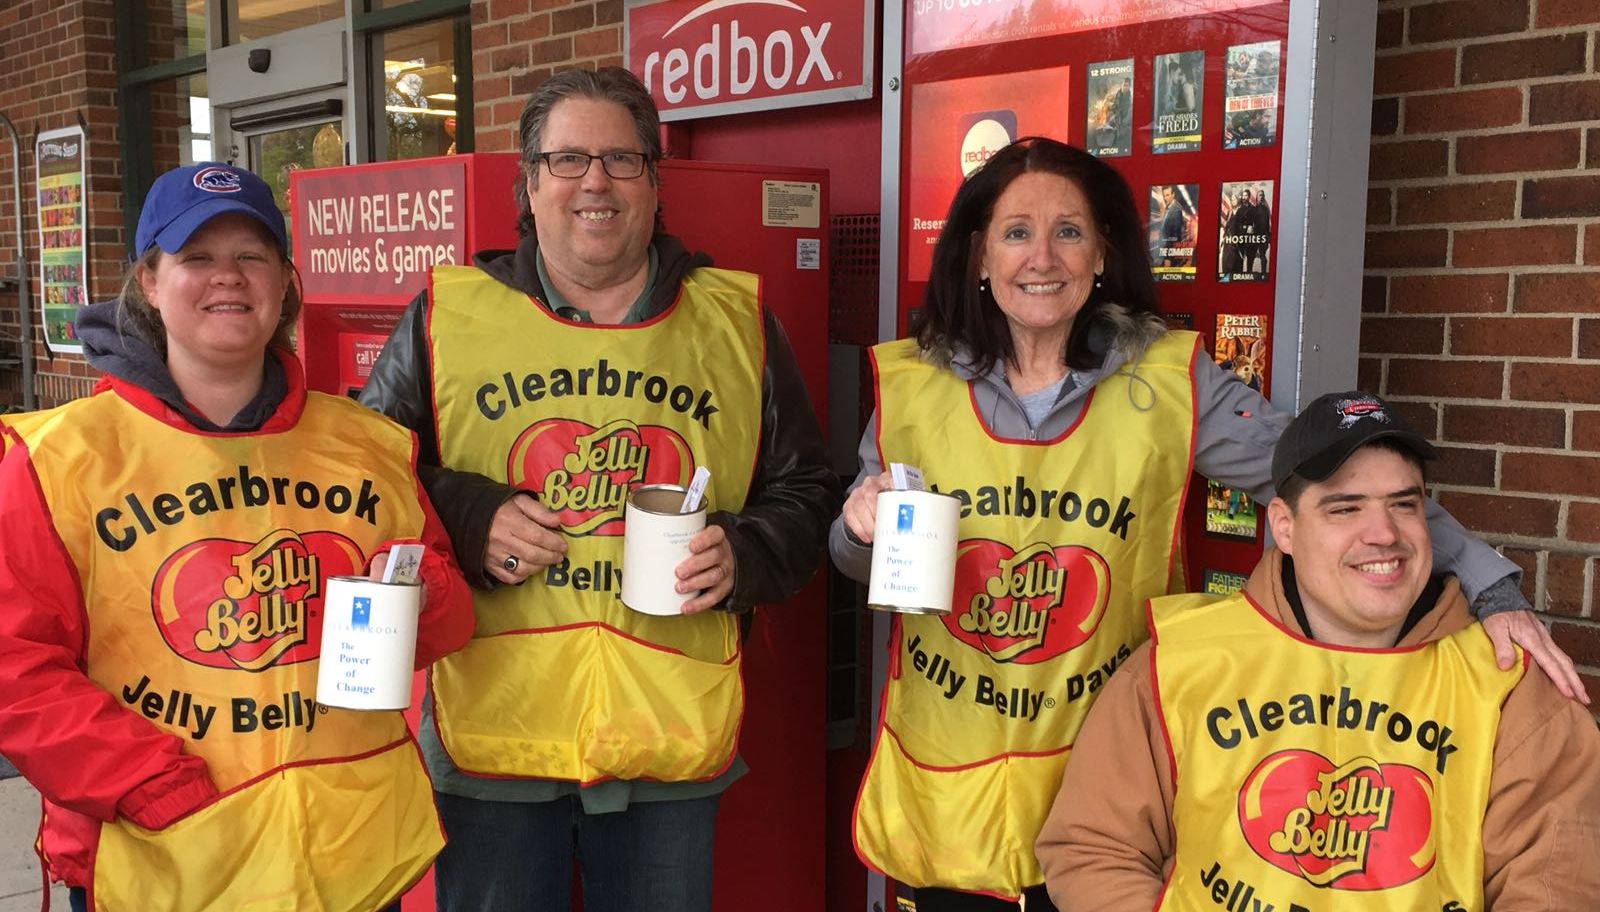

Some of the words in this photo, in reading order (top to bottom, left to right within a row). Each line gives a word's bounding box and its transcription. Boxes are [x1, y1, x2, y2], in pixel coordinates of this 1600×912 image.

[1071, 16, 1099, 28] various
[644, 20, 834, 104] redbox
[1090, 69, 1099, 77] 12
[1100, 65, 1132, 76] STRONG
[1159, 118, 1199, 133] FREED
[965, 146, 997, 163] redbo
[1099, 146, 1119, 155] ACTION
[1167, 142, 1187, 151] DRAMA
[1239, 137, 1261, 146] ACTION
[308, 197, 354, 236] NEW
[360, 189, 455, 233] RELEASE
[1159, 248, 1168, 256] THE
[1168, 248, 1194, 256] COMMUTER
[1225, 235, 1267, 244] HOSTILES
[311, 239, 372, 274] movies
[375, 238, 388, 273] &
[393, 244, 456, 284] games
[1221, 327, 1262, 340] RABBIT
[1223, 315, 1260, 327] PETER
[356, 350, 370, 365] call
[476, 359, 719, 431] Clearbrook
[563, 425, 650, 484] Jelly
[539, 469, 629, 513] Belly
[95, 465, 381, 552] Clearbrook
[930, 475, 1136, 540] earbrook
[222, 535, 321, 601] Jelly
[986, 553, 1068, 609] Jelly
[1213, 573, 1247, 586] FATHER
[194, 594, 307, 656] Belly
[958, 592, 1048, 648] Belly
[339, 653, 372, 665] Power
[341, 642, 355, 650] The
[345, 669, 357, 678] of
[908, 634, 967, 700] Jelly
[336, 682, 376, 695] Change
[122, 675, 217, 740] Jelly
[1206, 686, 1458, 775] Clearbrook
[1306, 762, 1395, 831] Jelly
[1268, 807, 1371, 865] Belly
